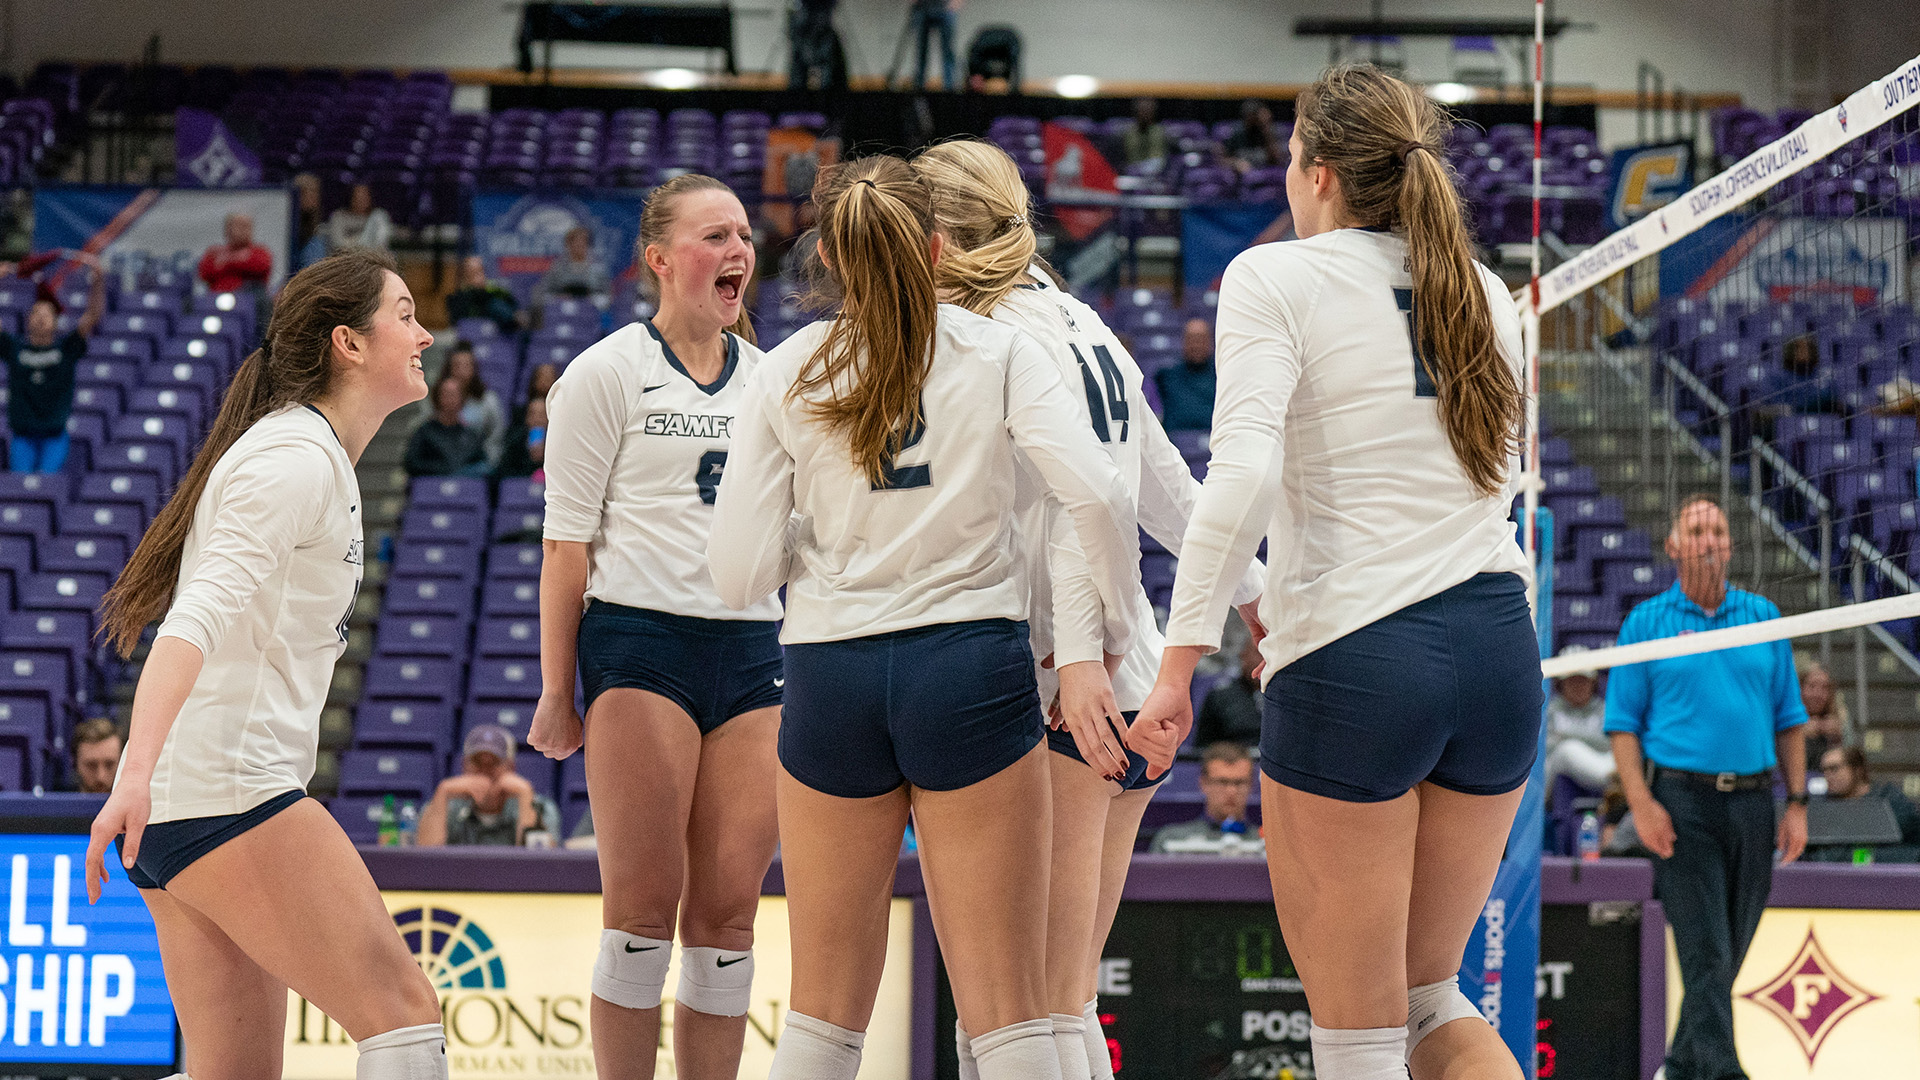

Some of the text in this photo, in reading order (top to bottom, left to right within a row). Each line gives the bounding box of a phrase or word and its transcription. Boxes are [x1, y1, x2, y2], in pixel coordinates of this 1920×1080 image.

[644, 413, 734, 439] SAMF
[1068, 342, 1130, 444] 14
[0, 854, 88, 947] LL
[0, 953, 137, 1048] HIP
[1790, 973, 1832, 1021] F
